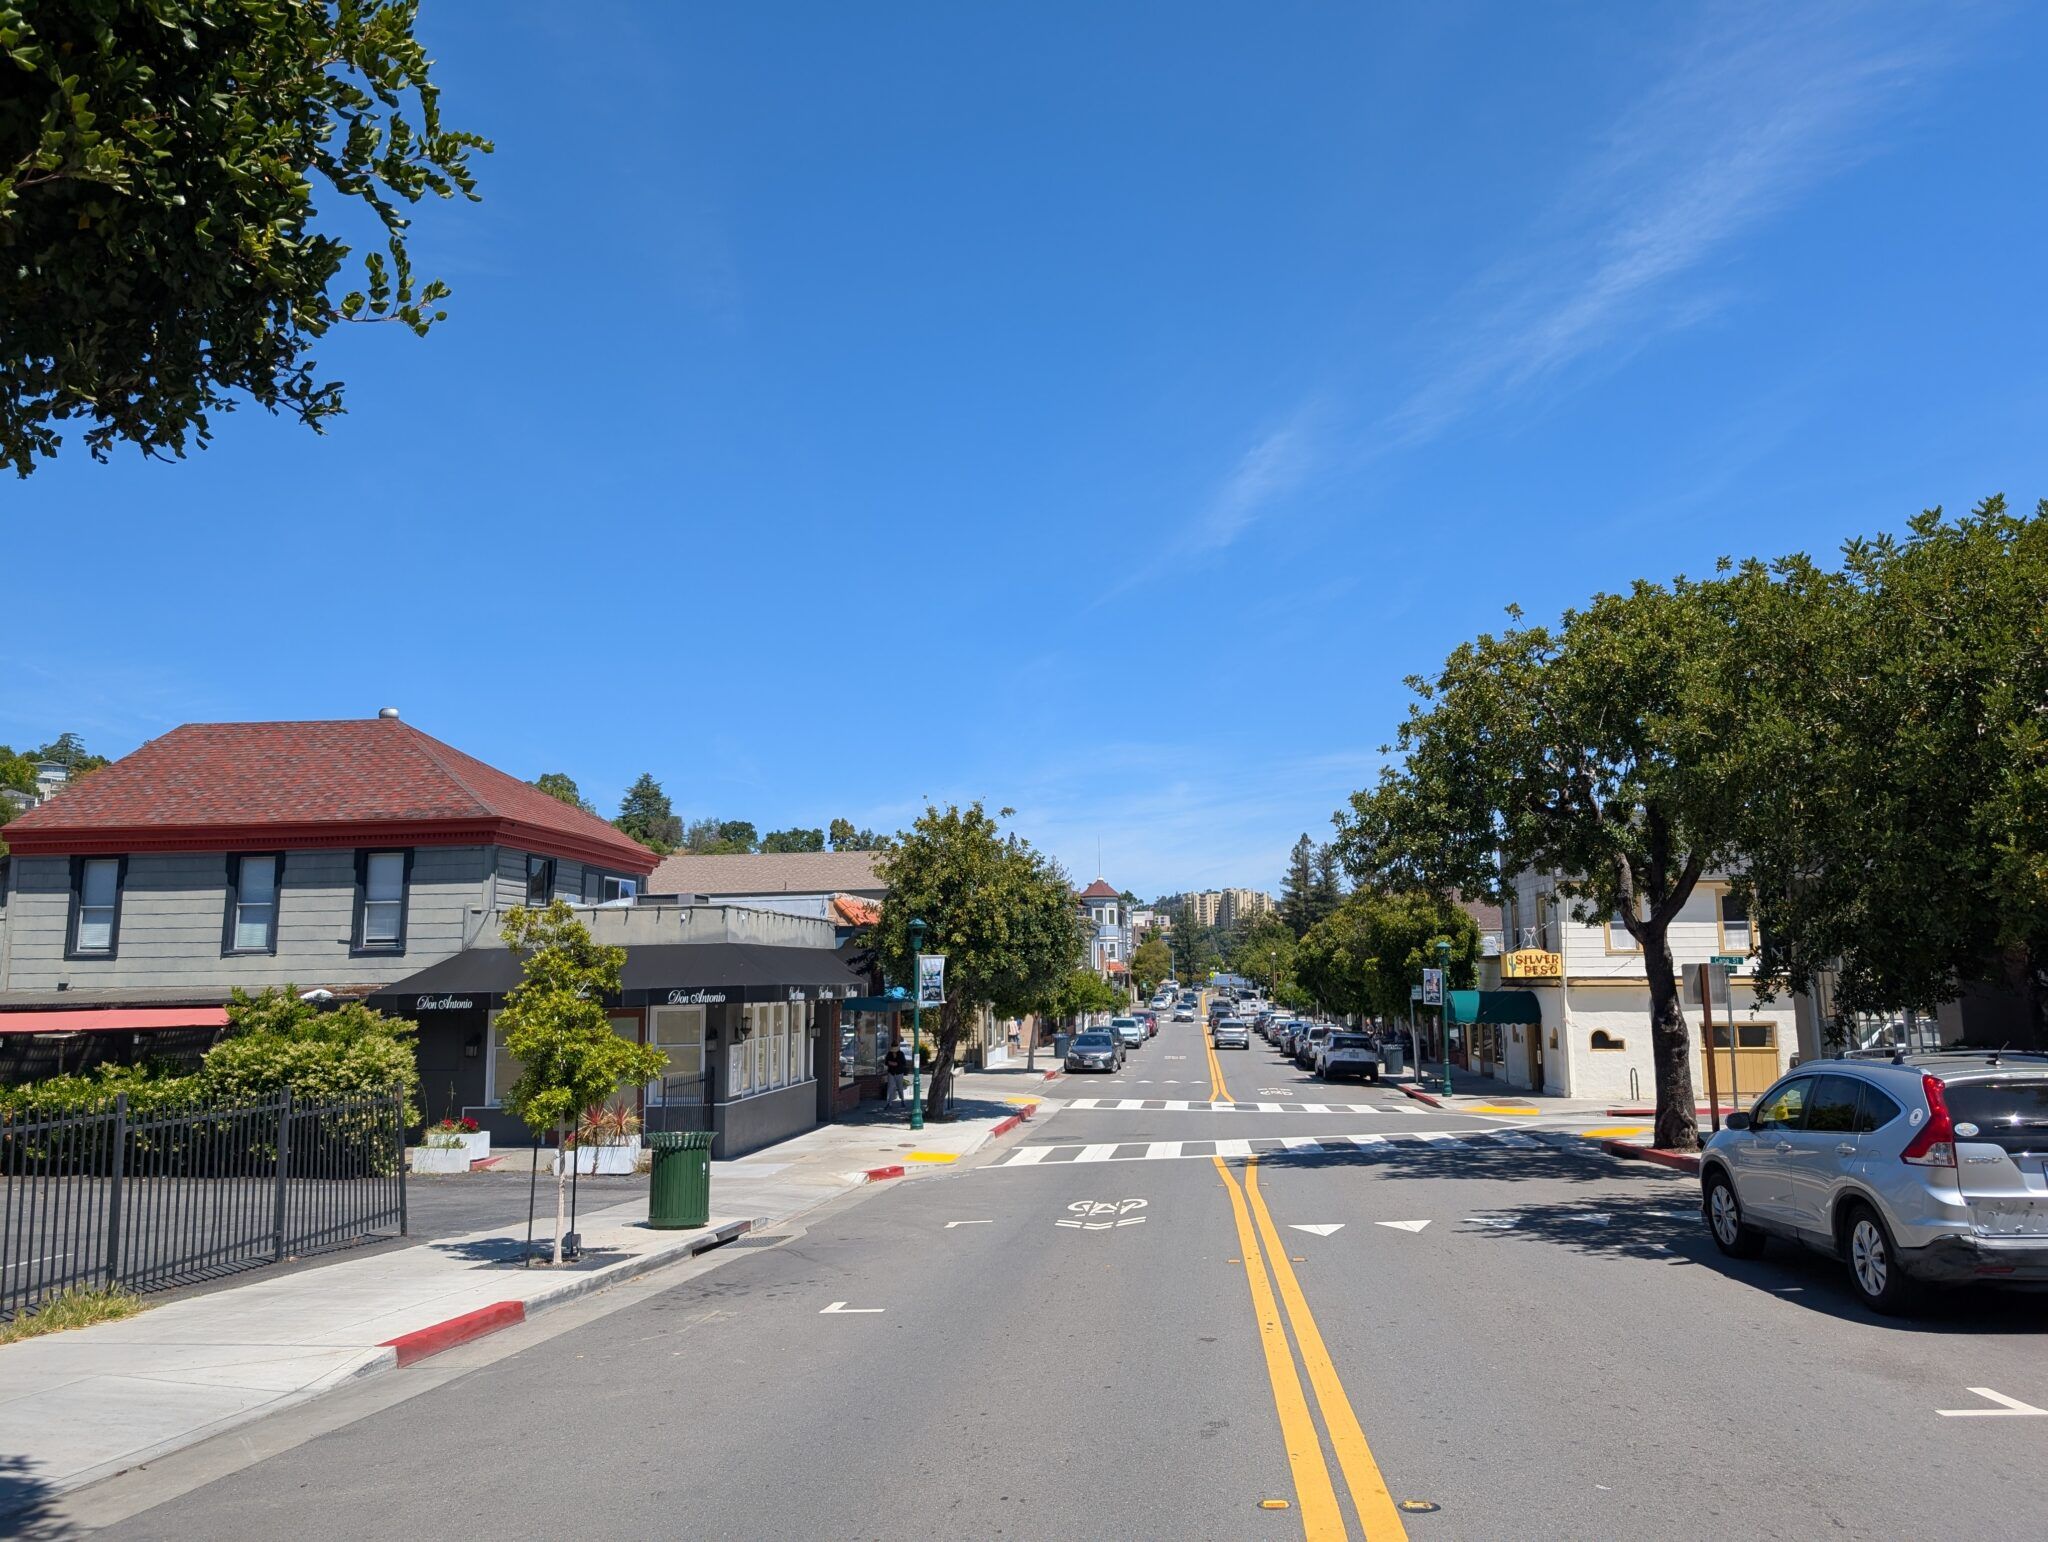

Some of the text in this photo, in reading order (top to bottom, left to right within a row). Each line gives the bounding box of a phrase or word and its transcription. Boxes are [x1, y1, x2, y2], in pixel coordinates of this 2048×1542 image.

[1515, 954, 1559, 965] SILVER
[1524, 965, 1558, 975] PESO
[416, 994, 473, 1010] Don Antonio
[667, 988, 726, 1004] Don Antonio
